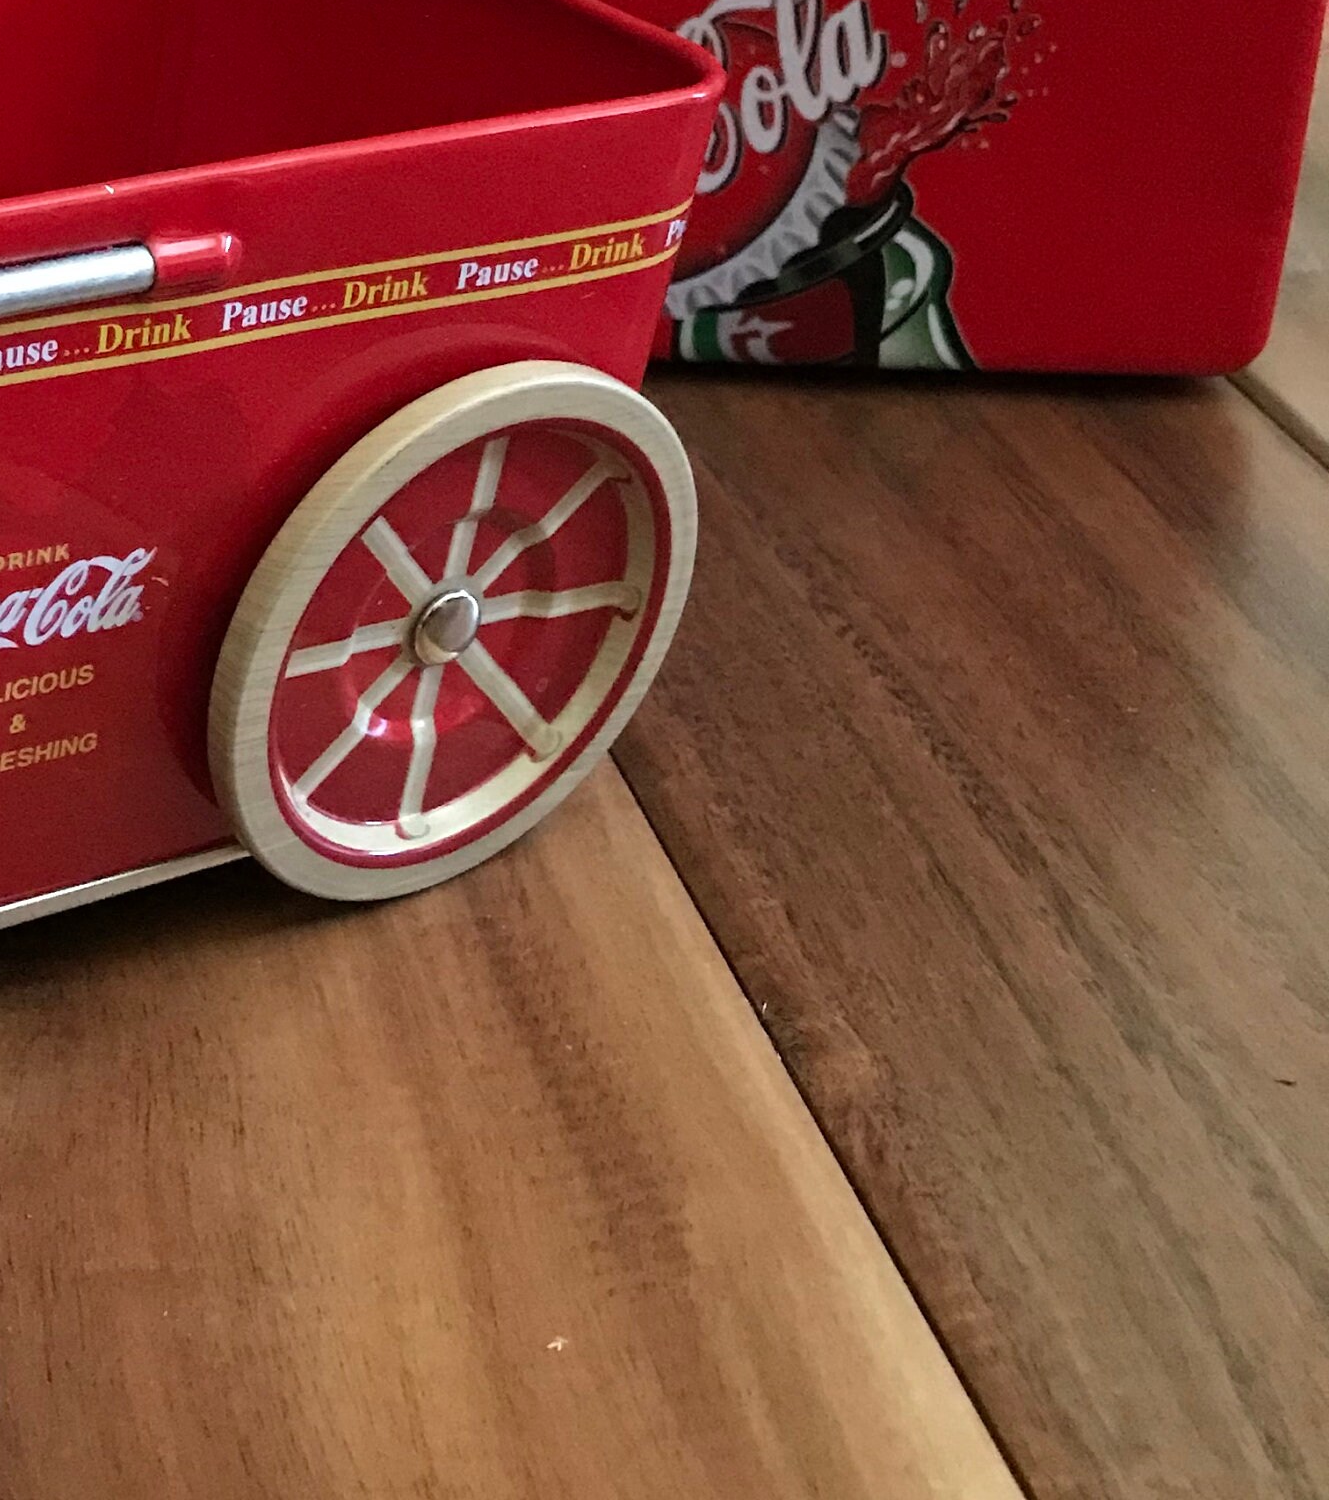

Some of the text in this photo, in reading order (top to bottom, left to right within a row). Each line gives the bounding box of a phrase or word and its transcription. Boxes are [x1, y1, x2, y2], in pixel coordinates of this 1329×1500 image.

[93, 313, 194, 355] Drink
[341, 271, 431, 311] Drink
[569, 233, 646, 272] Drink
[8, 713, 27, 734] &
